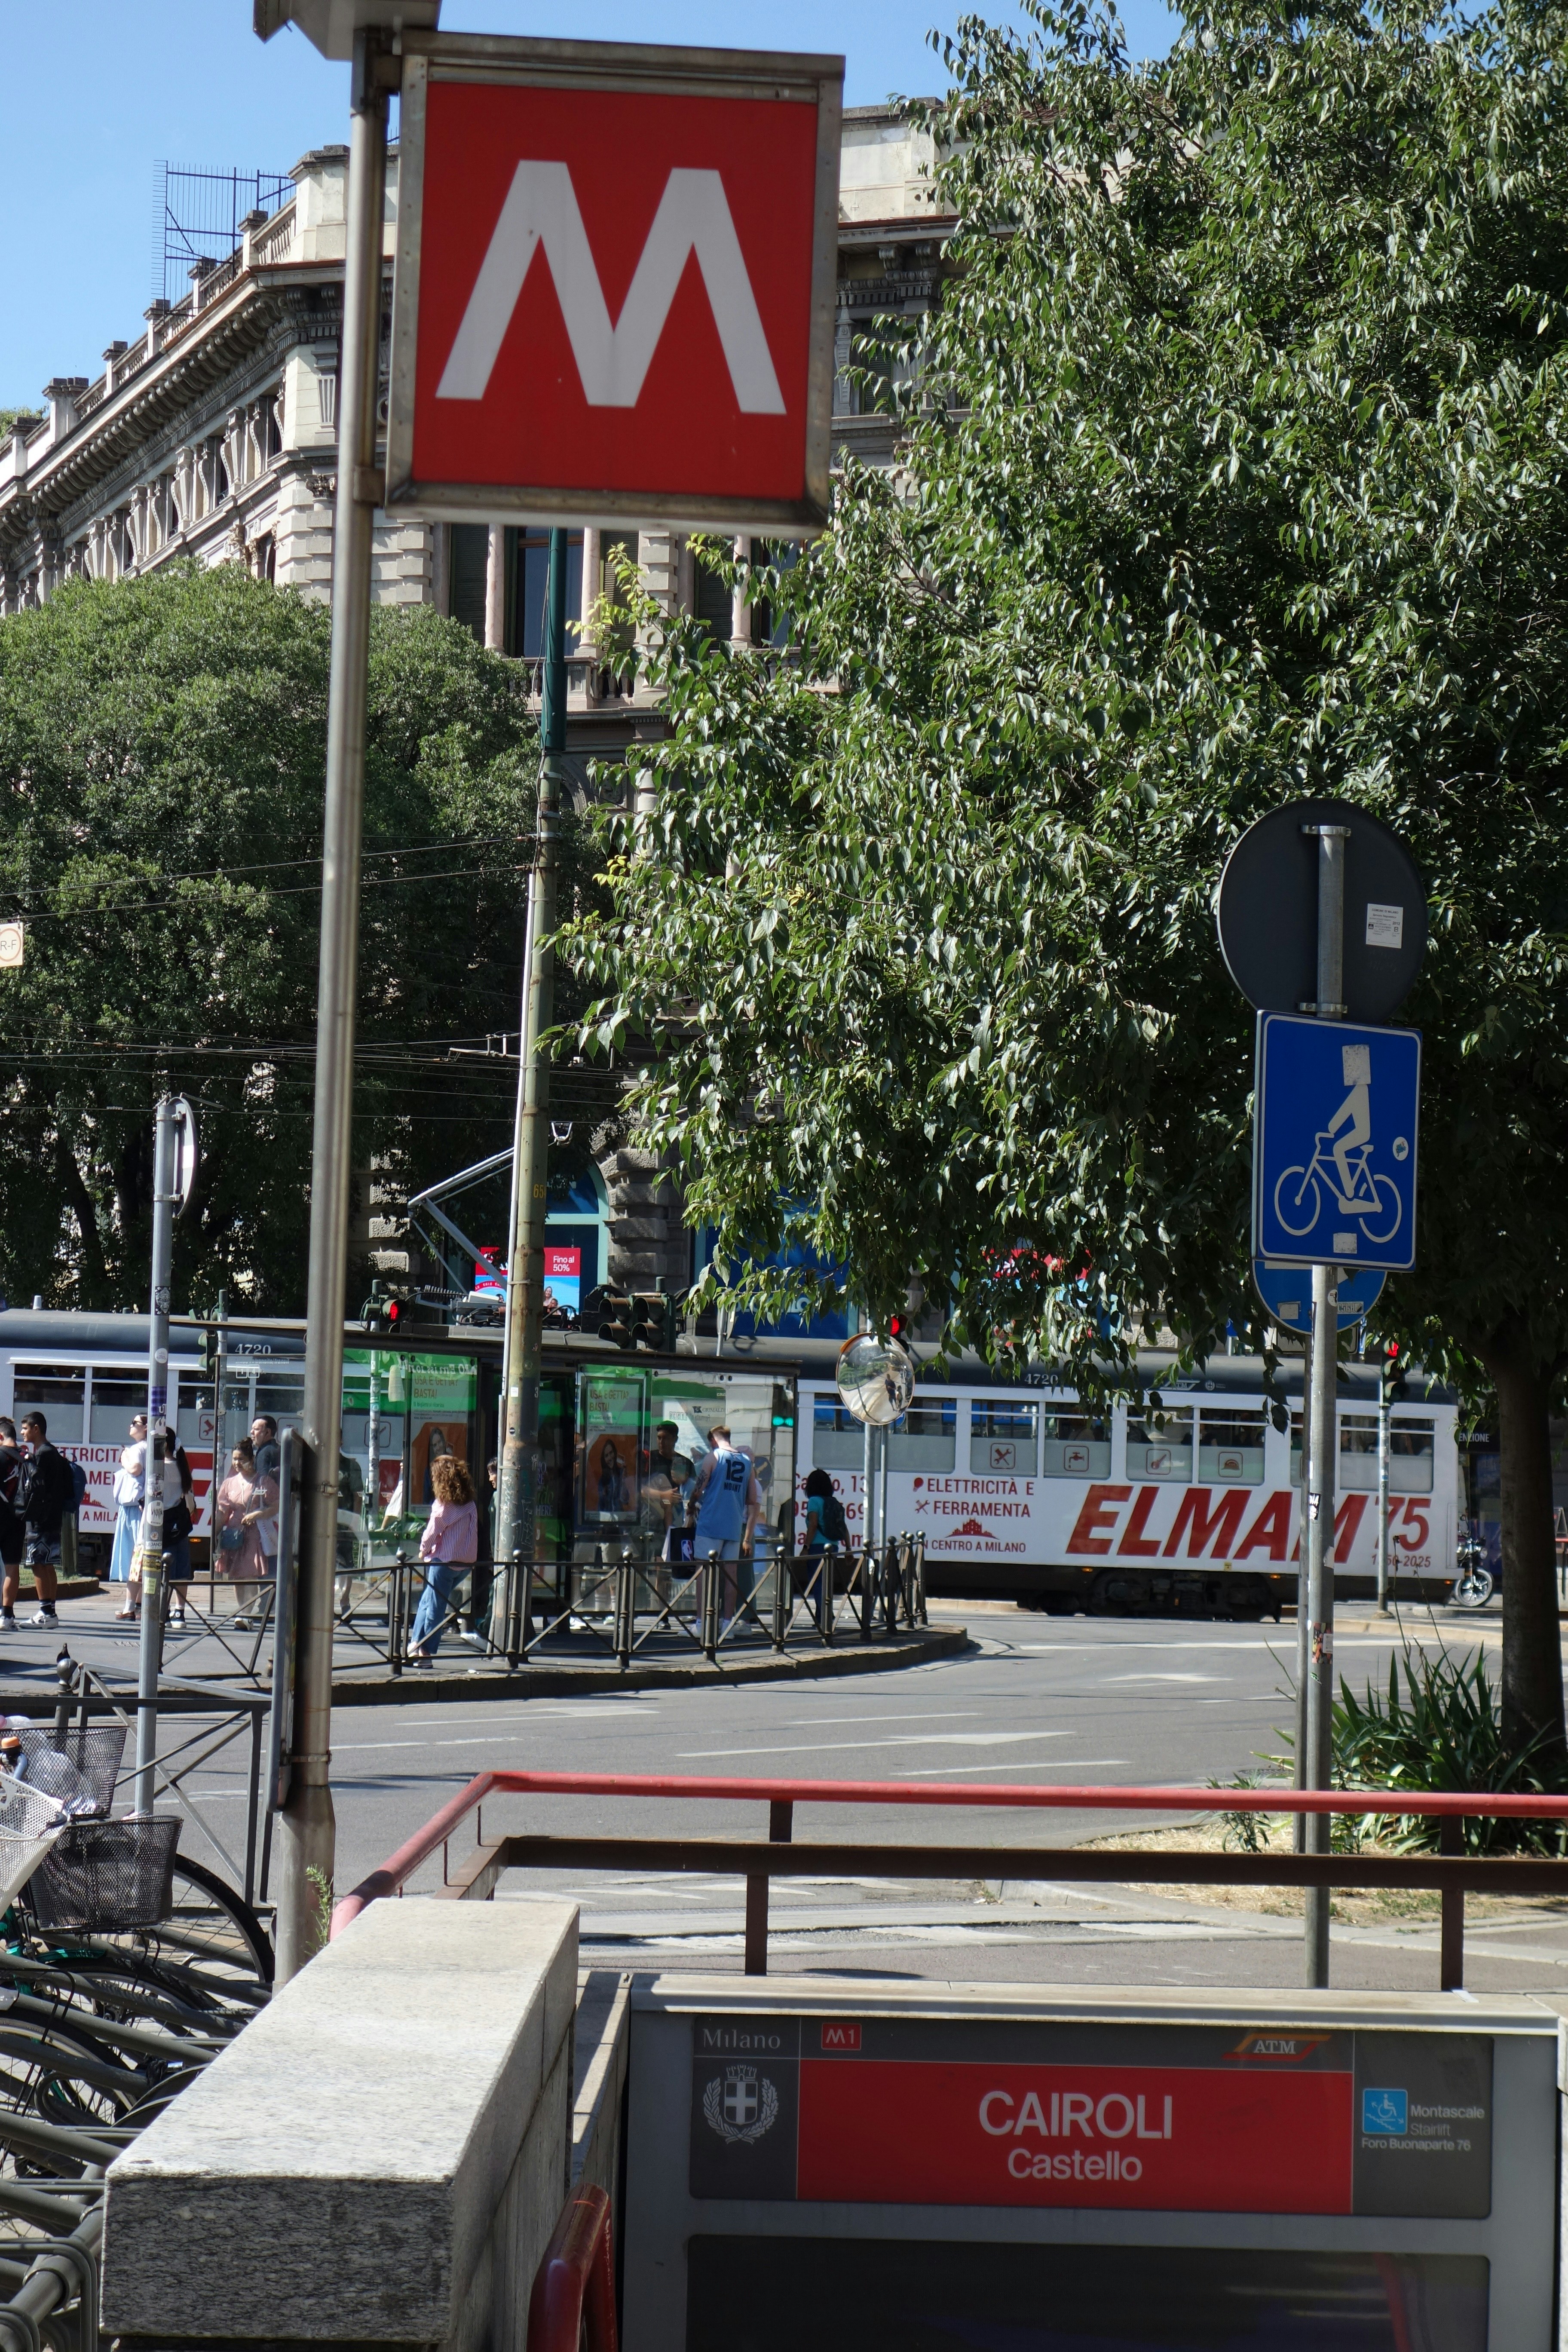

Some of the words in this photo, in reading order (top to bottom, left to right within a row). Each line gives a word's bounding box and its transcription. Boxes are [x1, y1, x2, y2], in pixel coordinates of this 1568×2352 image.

[435, 159, 787, 415] M
[0, 939, 17, 951] R-F
[553, 1256, 568, 1264] Fino
[568, 1256, 575, 1264] al
[553, 1264, 570, 1272] 50%
[235, 1344, 271, 1354] 4720
[1024, 1374, 1059, 1385] 4720
[414, 1388, 437, 1399] BASTA!
[725, 1459, 746, 1483] 12
[927, 1477, 1018, 1495] ELETTRICITÀ
[1026, 1482, 1035, 1496] E
[82, 1510, 90, 1522] A
[934, 1500, 1031, 1518] FERRAMENTA
[1375, 1496, 1431, 1553] 75
[931, 1539, 973, 1551] CENTRO
[975, 1541, 983, 1551] A
[985, 1542, 1026, 1553] MILANO
[1372, 1553, 1431, 1568] 150-2025
[702, 2028, 781, 2049] Milano
[825, 2028, 855, 2045] M1
[1253, 2039, 1296, 2055] ATM
[979, 2089, 1173, 2140] CAIROLI
[1410, 2104, 1485, 2119] Montascale
[1410, 2123, 1451, 2137] Stairlift
[1361, 2137, 1387, 2149] Foro
[1389, 2138, 1455, 2152] Buonaparte
[1456, 2139, 1472, 2151] 76
[1008, 2147, 1143, 2182] Castello
